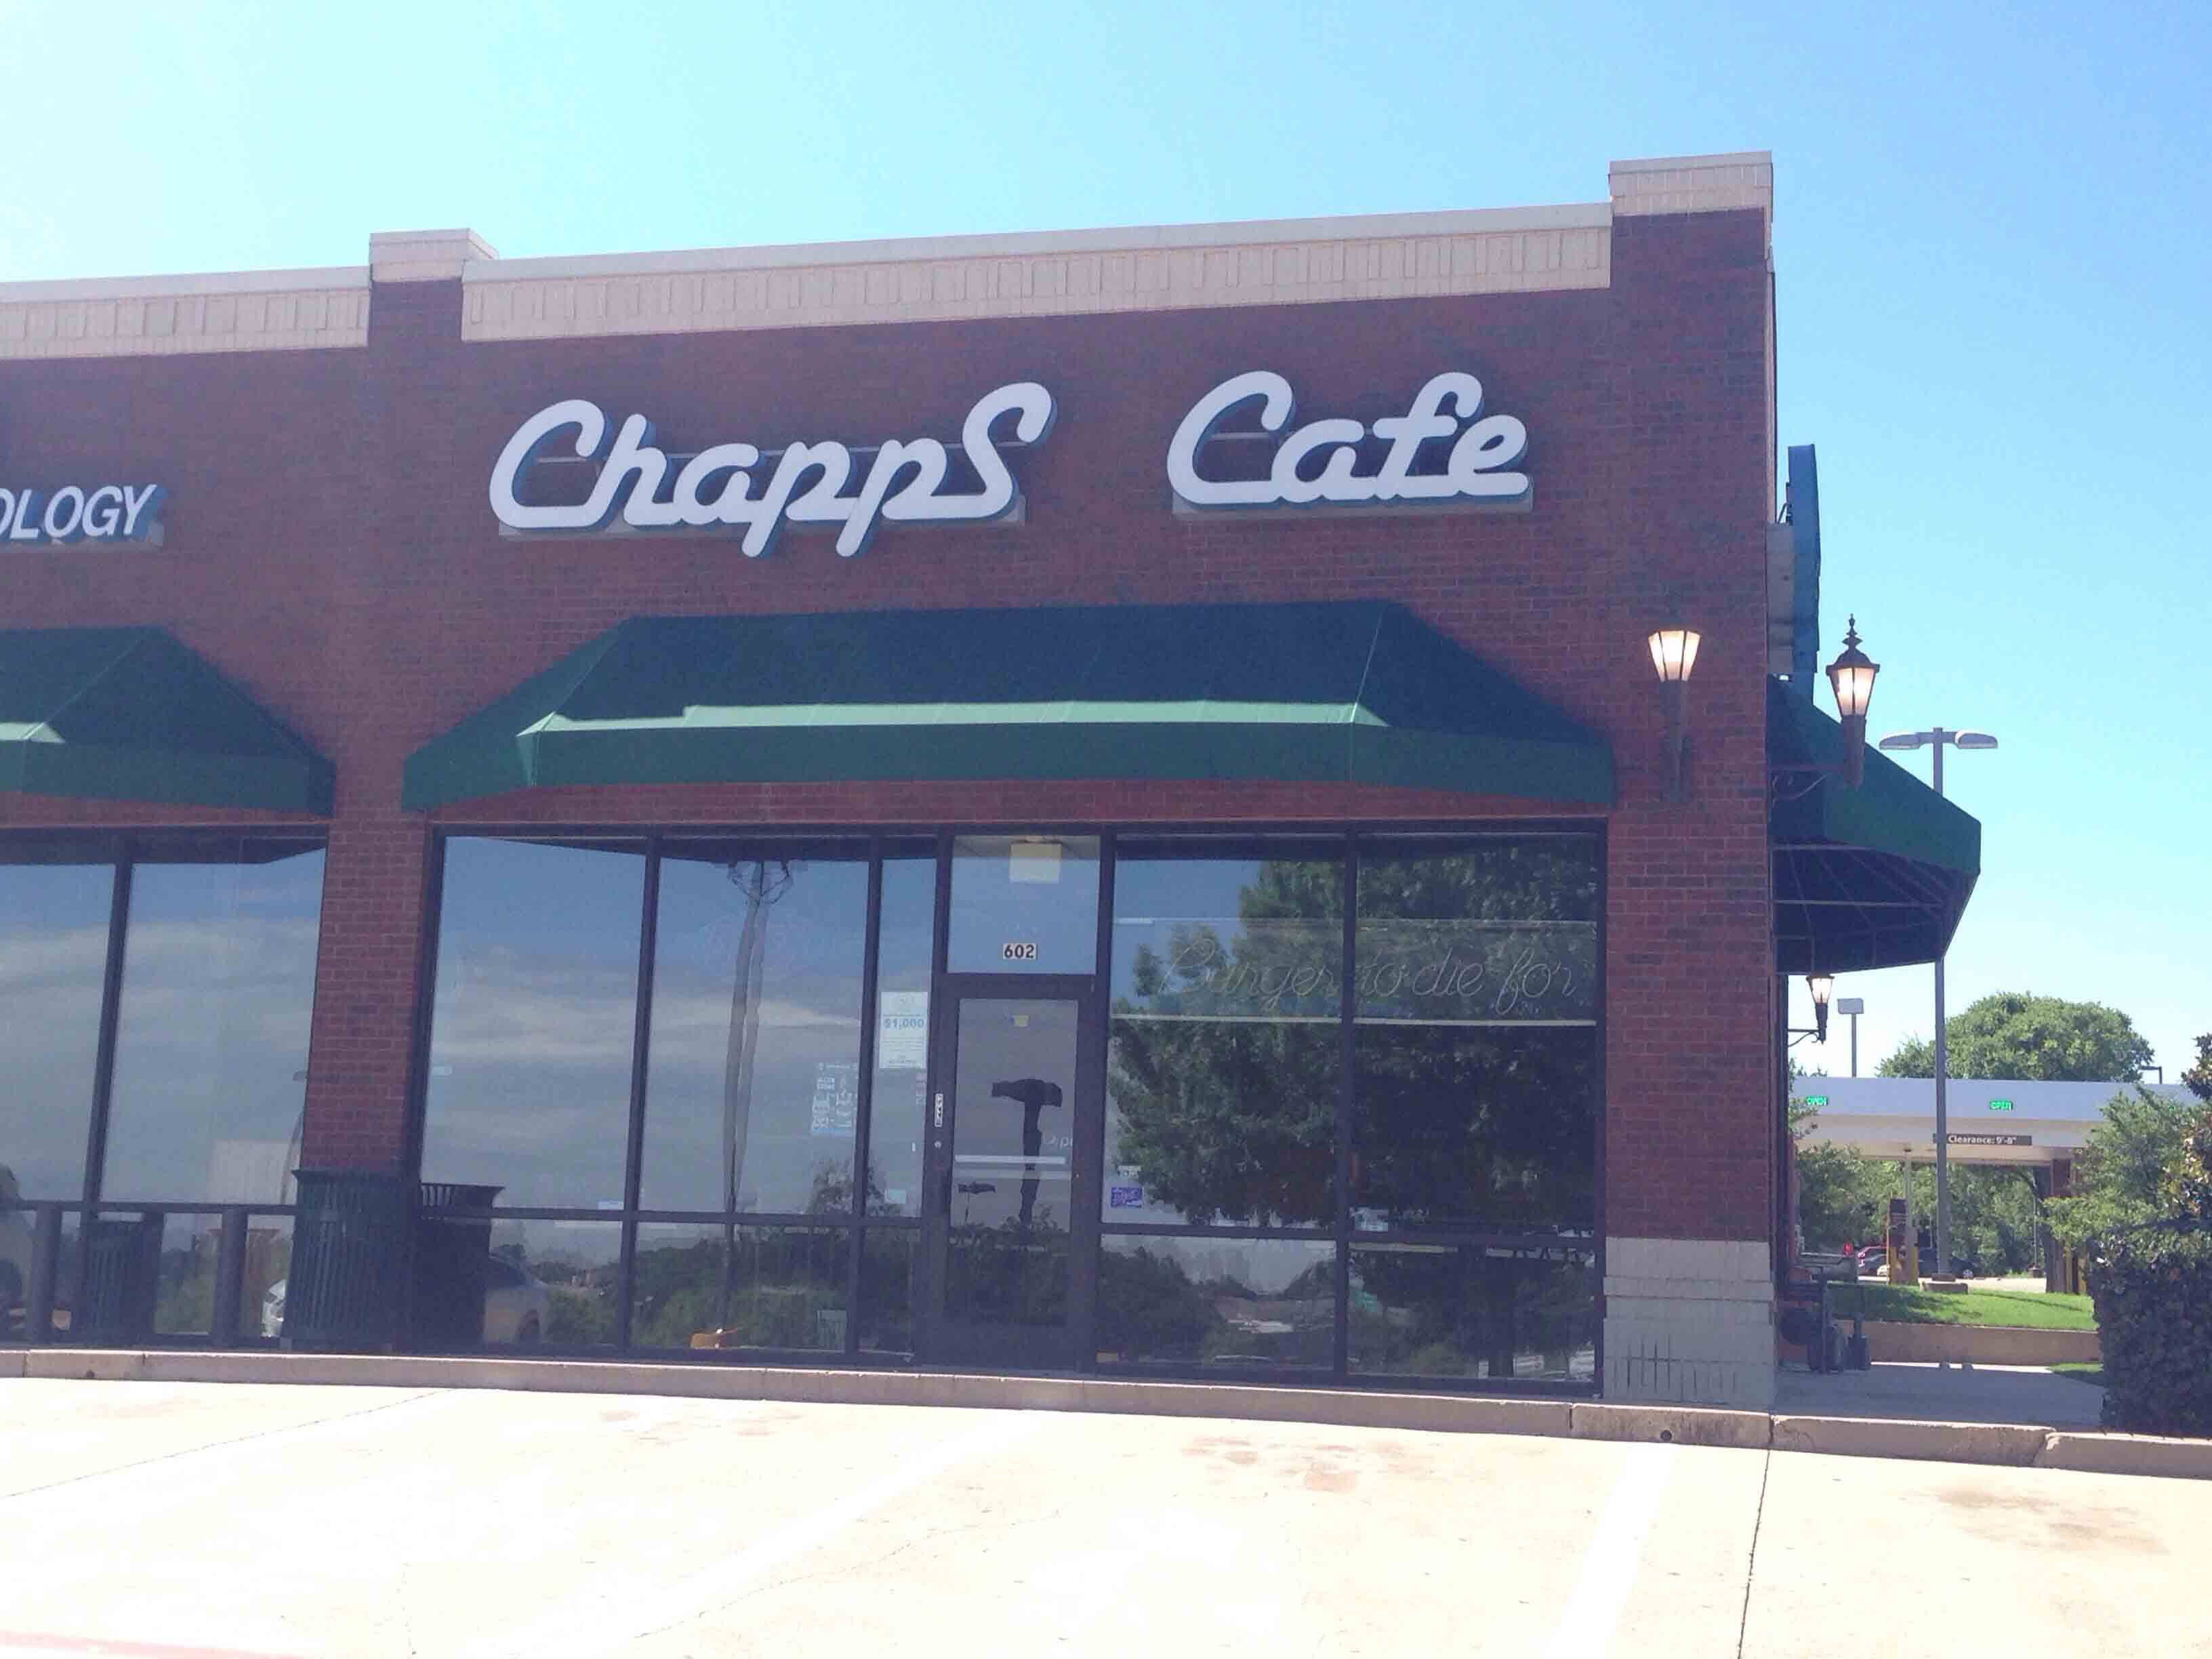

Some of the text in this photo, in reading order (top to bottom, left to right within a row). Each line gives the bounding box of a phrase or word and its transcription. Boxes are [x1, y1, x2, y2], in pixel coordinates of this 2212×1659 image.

[1166, 370, 1530, 504] Cafe
[1004, 943, 1036, 959] 602
[1356, 949, 1407, 996] to
[1412, 948, 1485, 996] die
[1495, 947, 1578, 1015] for
